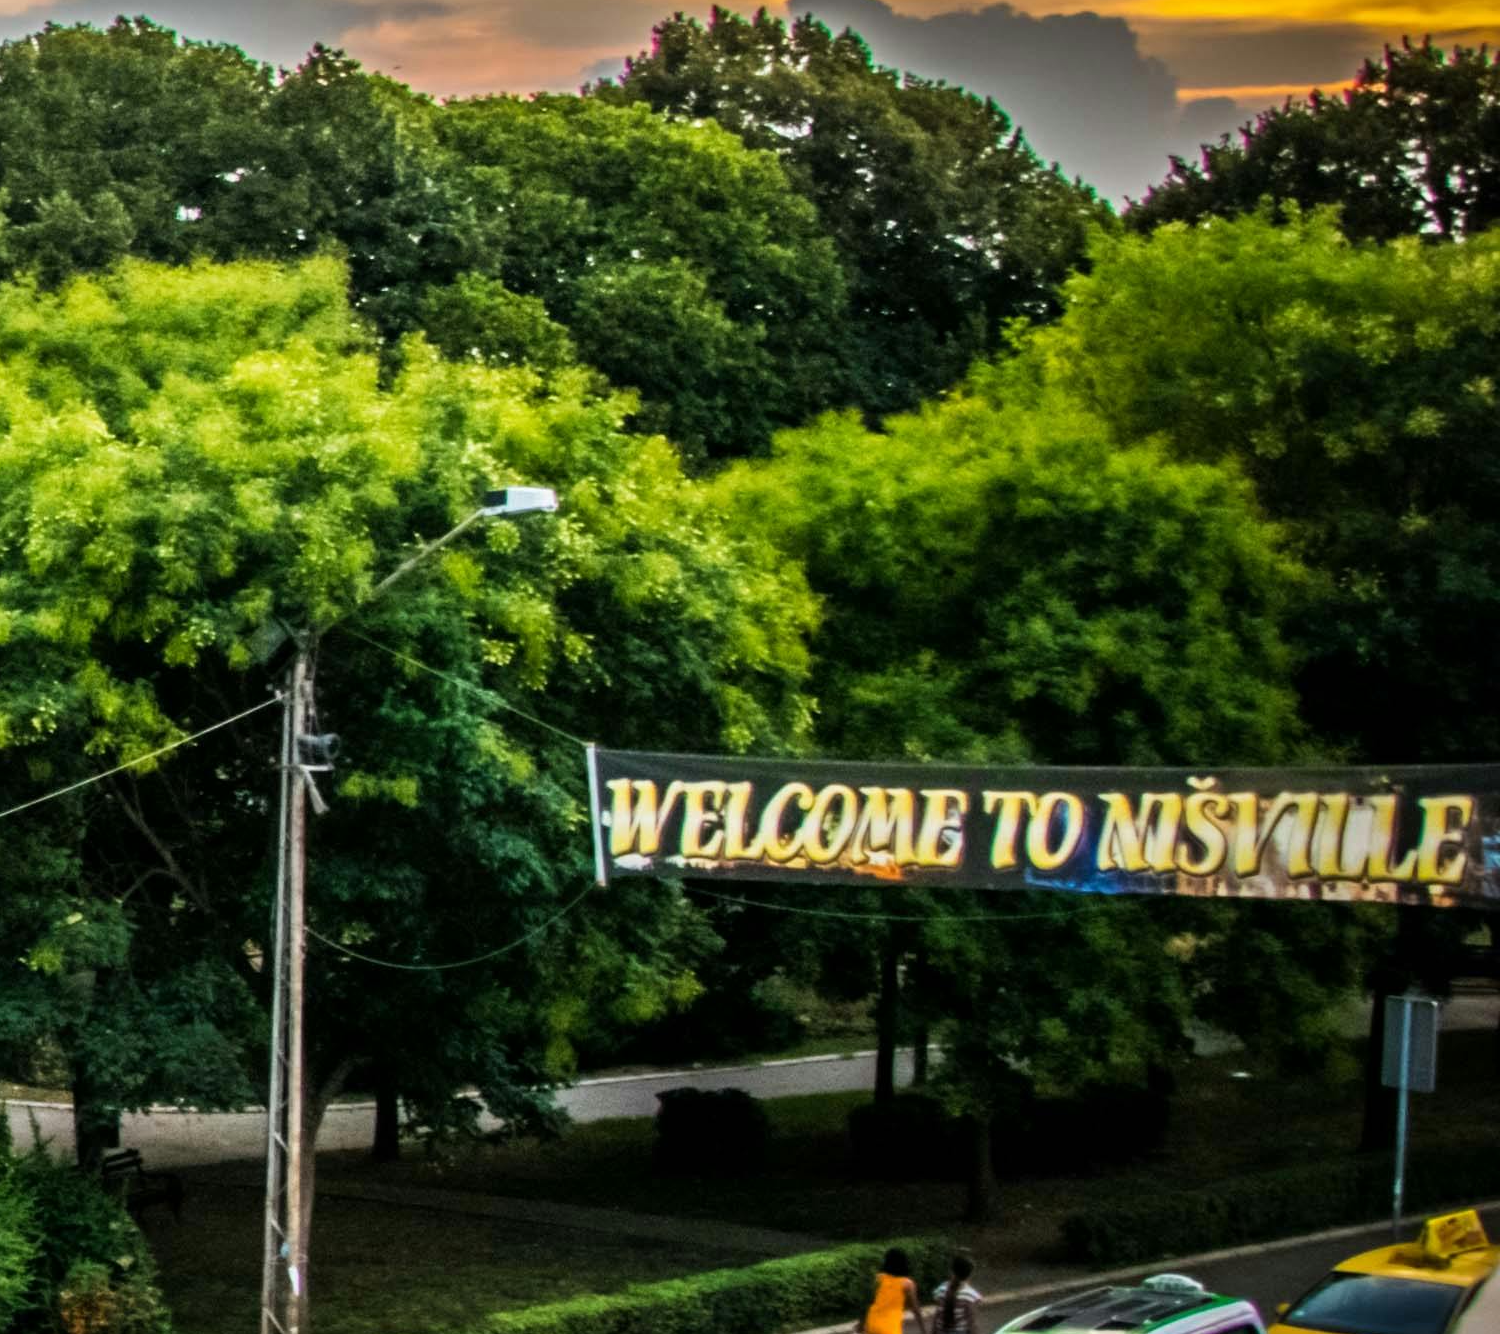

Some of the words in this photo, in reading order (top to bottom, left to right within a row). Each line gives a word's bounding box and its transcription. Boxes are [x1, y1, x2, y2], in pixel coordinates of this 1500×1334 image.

[605, 777, 969, 869] WELCOME
[982, 788, 1086, 872] TO
[1096, 775, 1476, 885] NIŠVILLE
